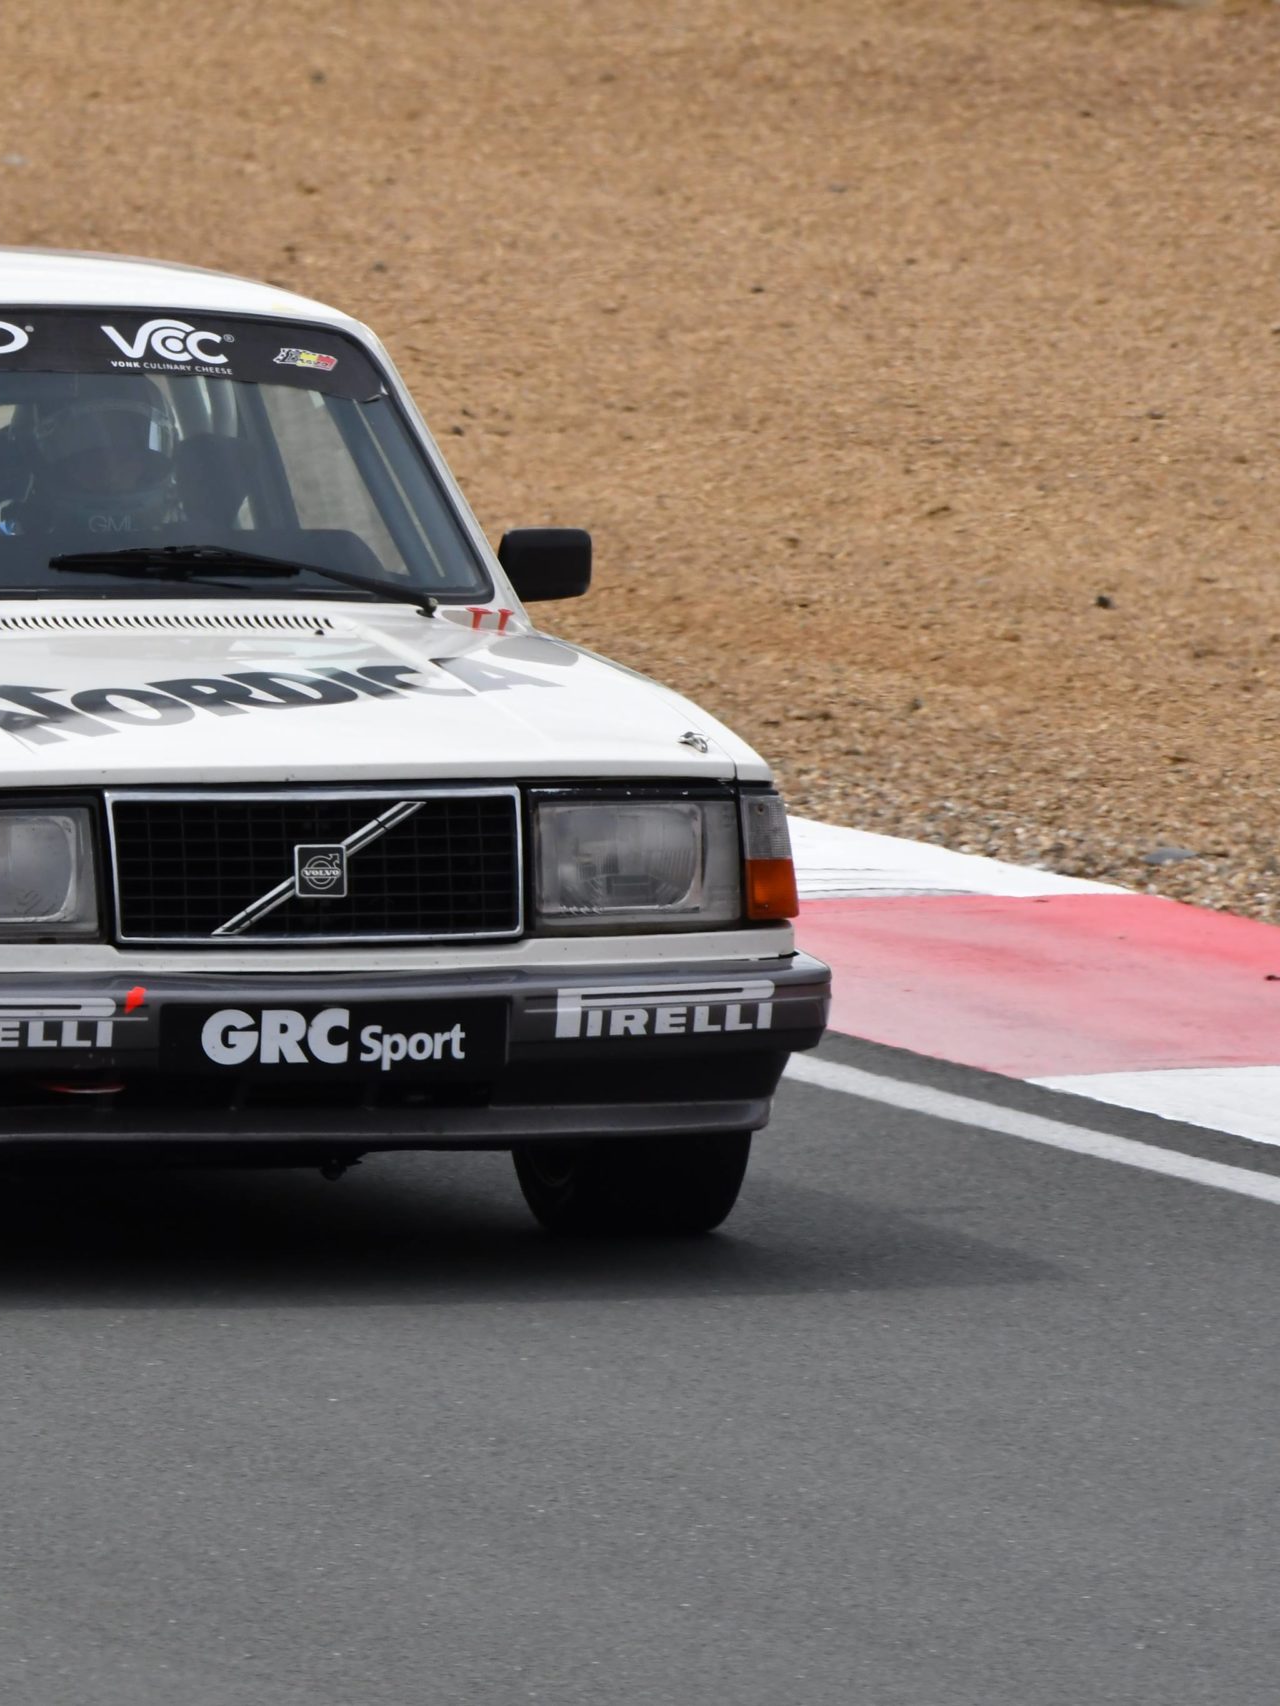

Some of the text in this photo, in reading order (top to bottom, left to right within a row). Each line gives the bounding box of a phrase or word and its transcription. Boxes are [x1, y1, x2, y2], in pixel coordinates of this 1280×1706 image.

[110, 360, 234, 375] VONK CULINARY CHEESE
[555, 980, 775, 1038] PIRELLI
[201, 1008, 465, 1071] GRC Sport
